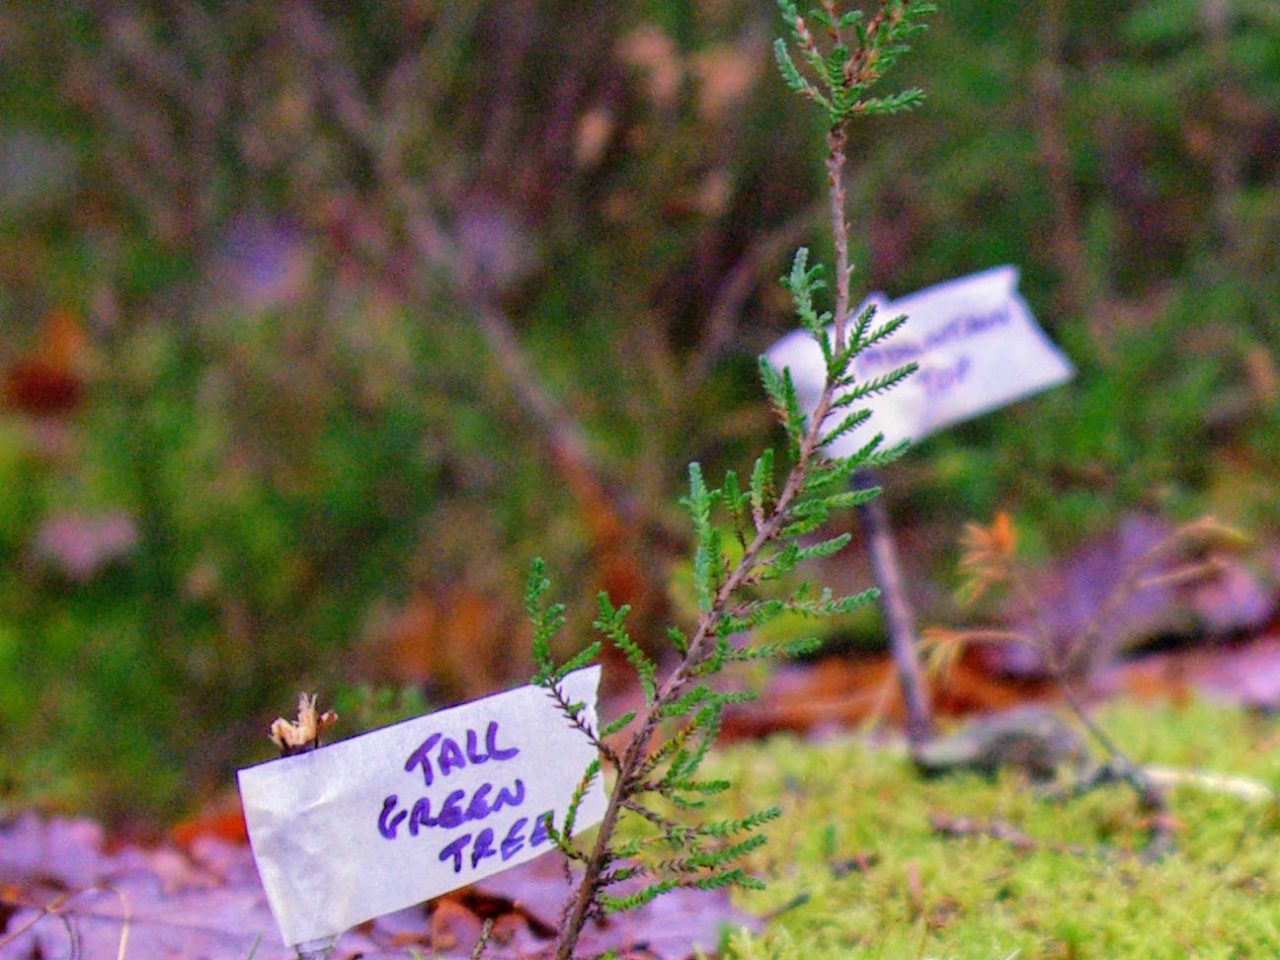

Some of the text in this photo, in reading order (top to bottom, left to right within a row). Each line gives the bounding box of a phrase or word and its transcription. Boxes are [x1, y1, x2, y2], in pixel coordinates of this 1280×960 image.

[404, 720, 520, 787] TALL
[377, 778, 526, 840] GREEN
[437, 812, 554, 874] TREE
